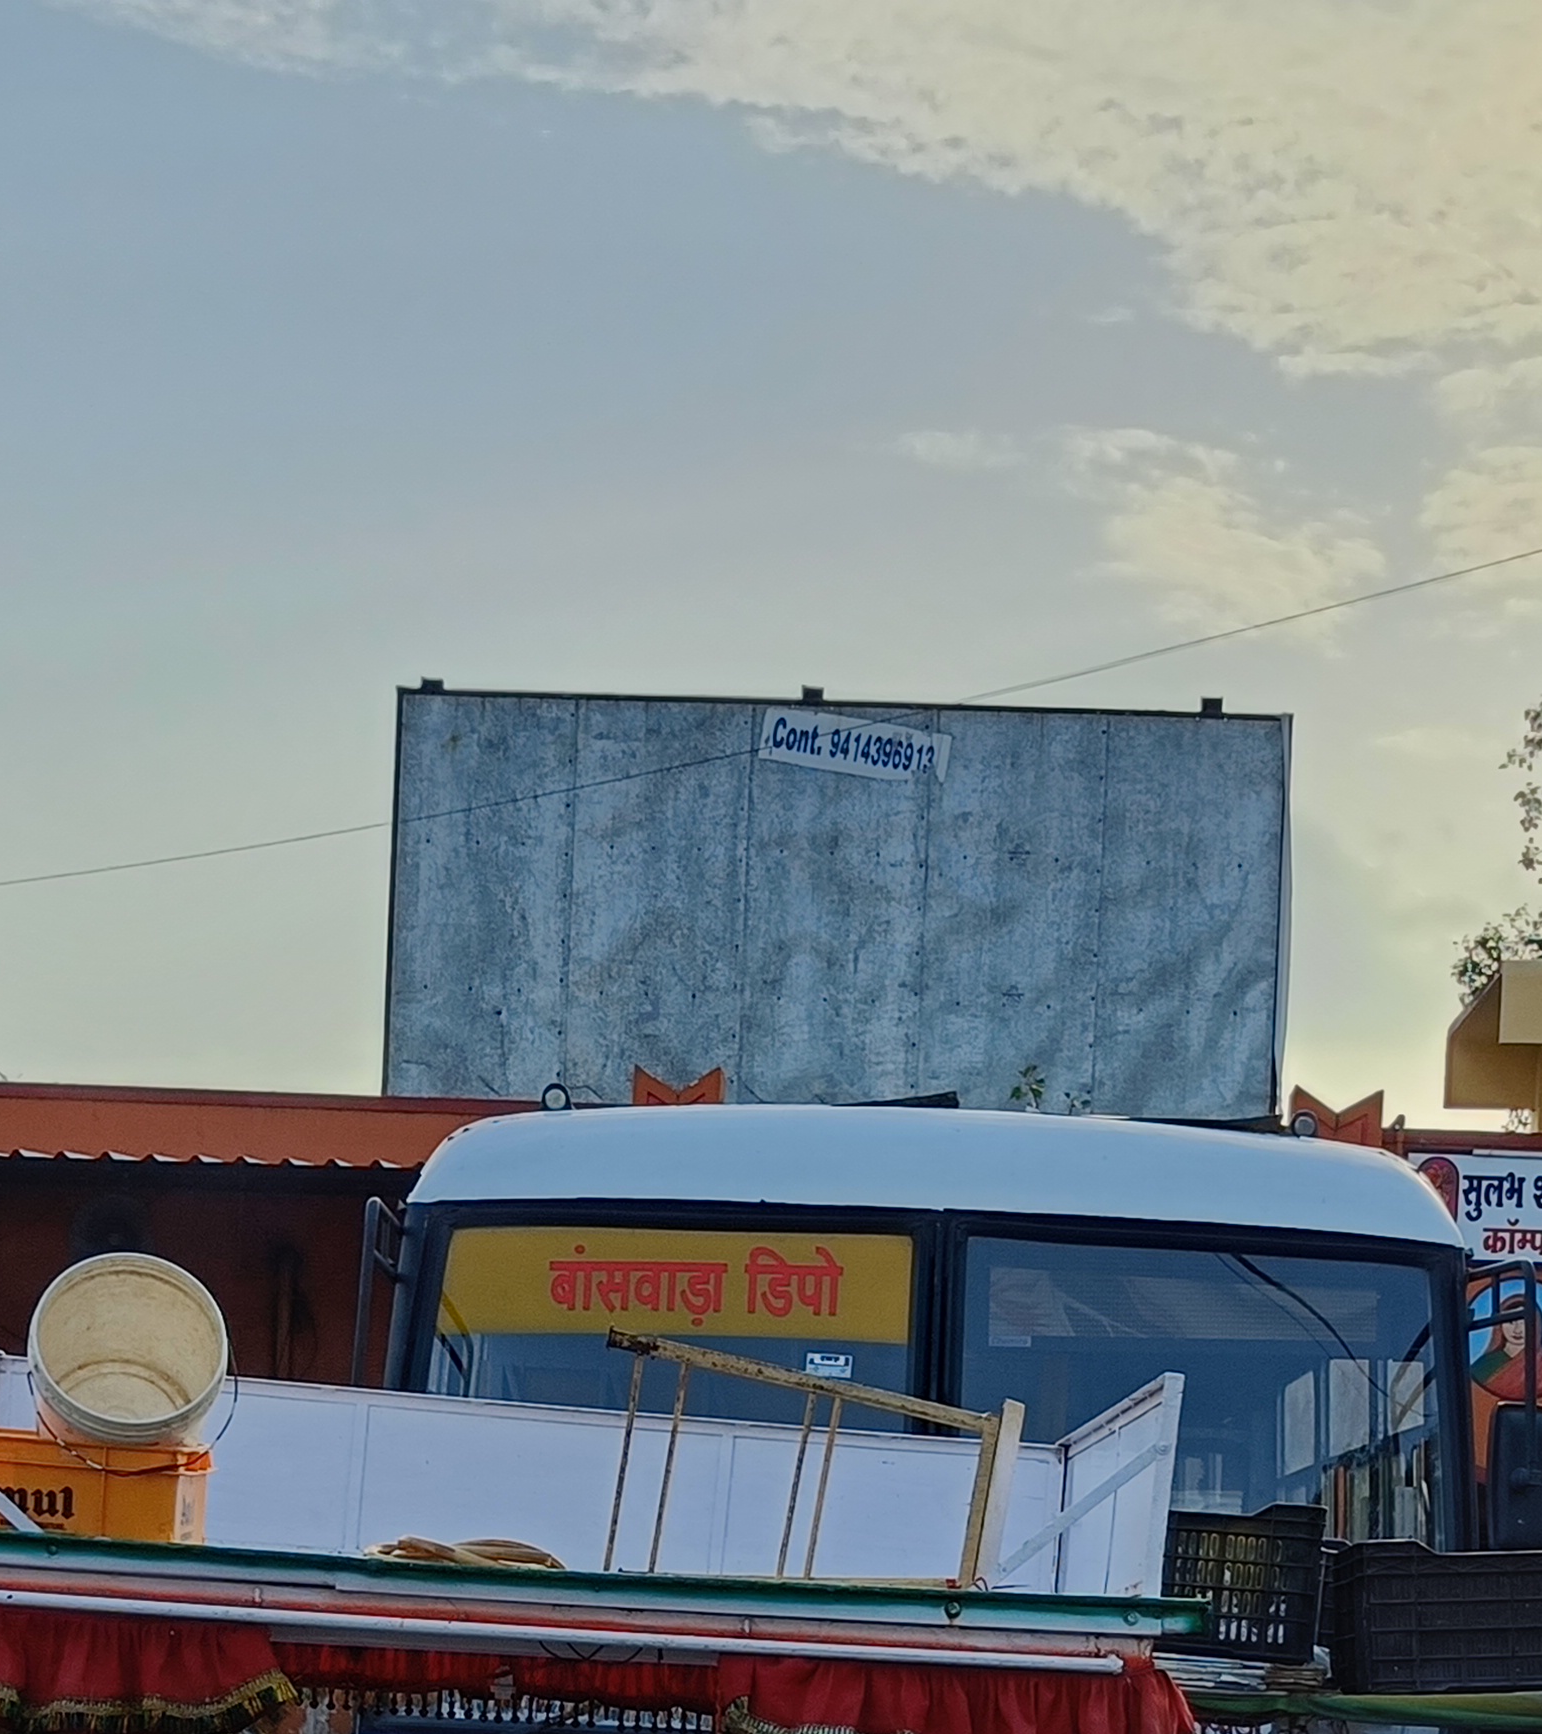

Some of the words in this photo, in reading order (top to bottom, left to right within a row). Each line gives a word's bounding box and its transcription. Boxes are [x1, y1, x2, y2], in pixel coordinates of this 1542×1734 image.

[772, 717, 822, 756] Cont.
[1462, 1172, 1526, 1221] सुलभ
[549, 1244, 728, 1328] बांसवाड़ा
[745, 1245, 844, 1317] डिपो
